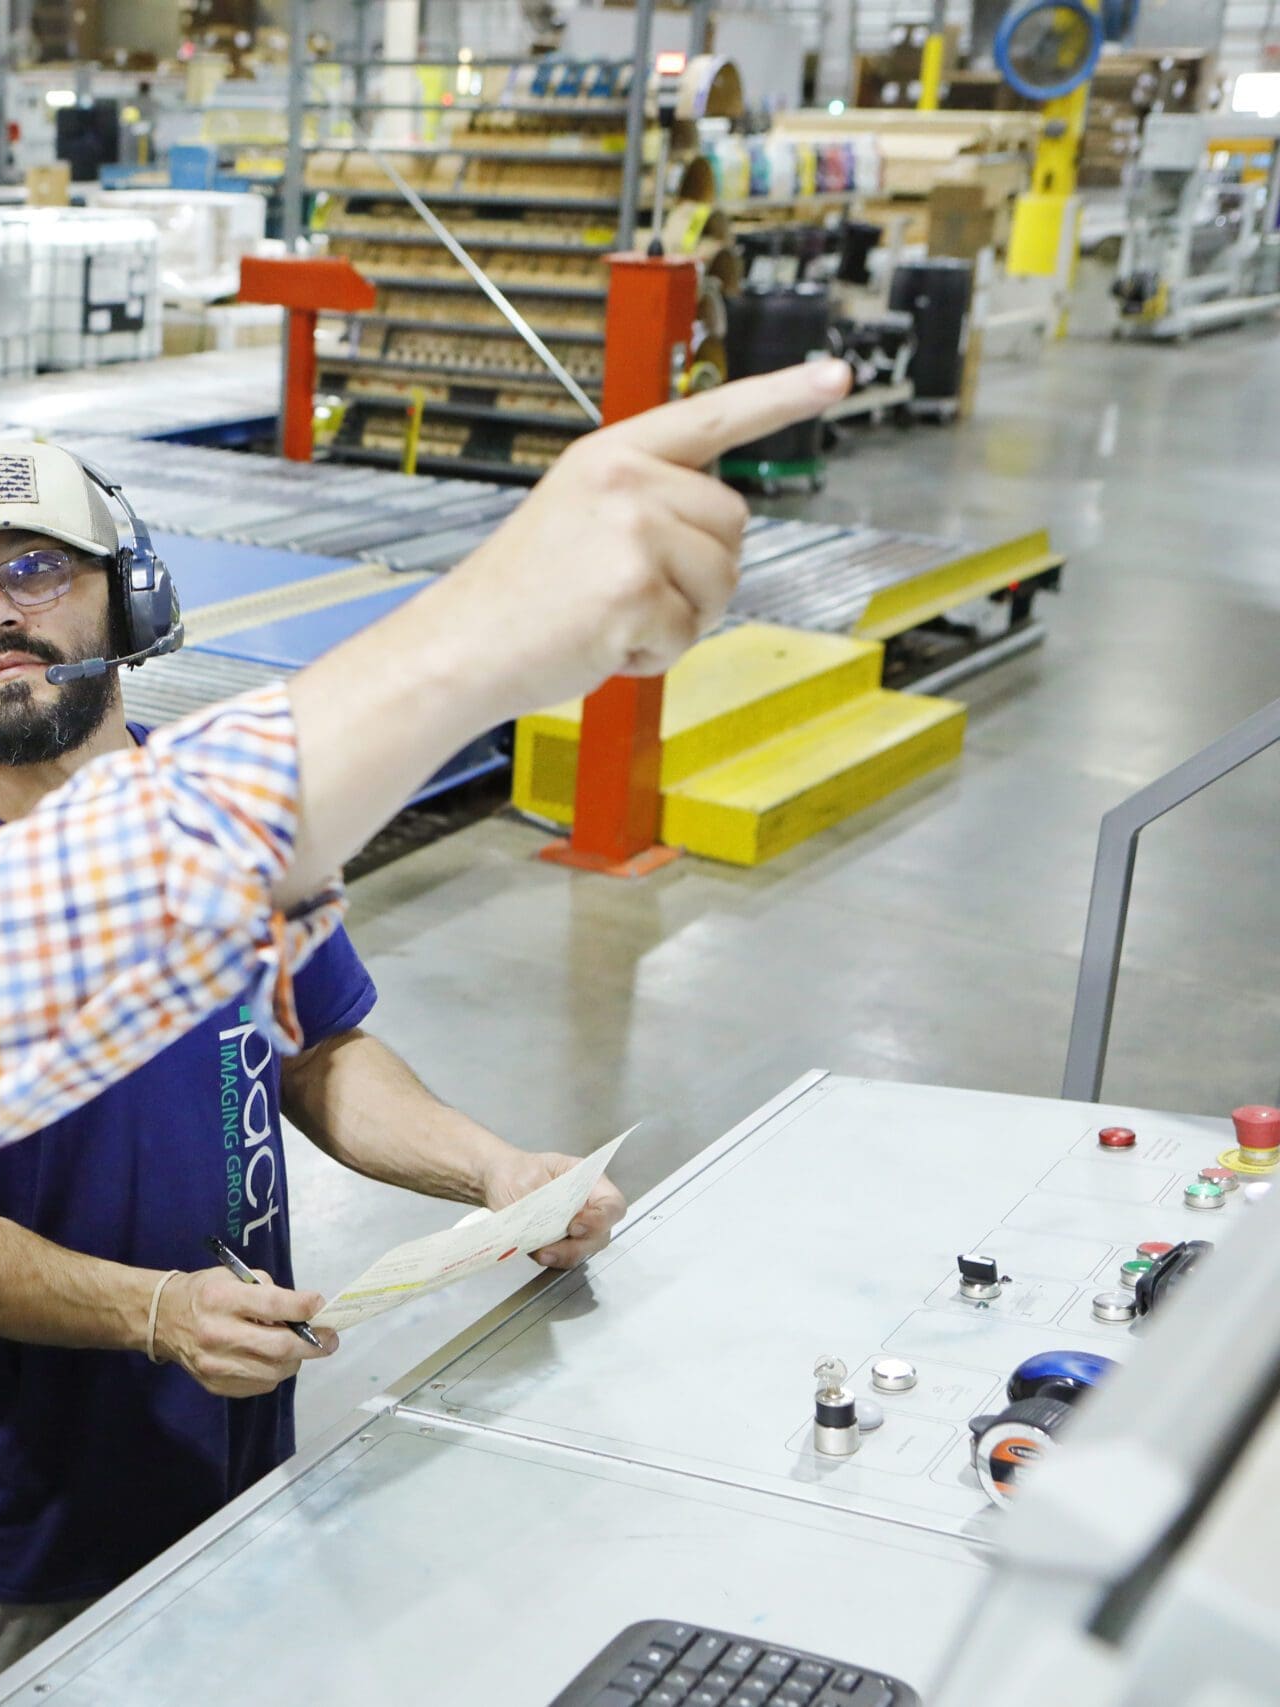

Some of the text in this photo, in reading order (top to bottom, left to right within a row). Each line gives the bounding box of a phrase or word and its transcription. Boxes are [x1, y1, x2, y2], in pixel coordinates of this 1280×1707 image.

[219, 1005, 280, 1248] pact
[219, 1042, 243, 1239] IMAGING GROUP
